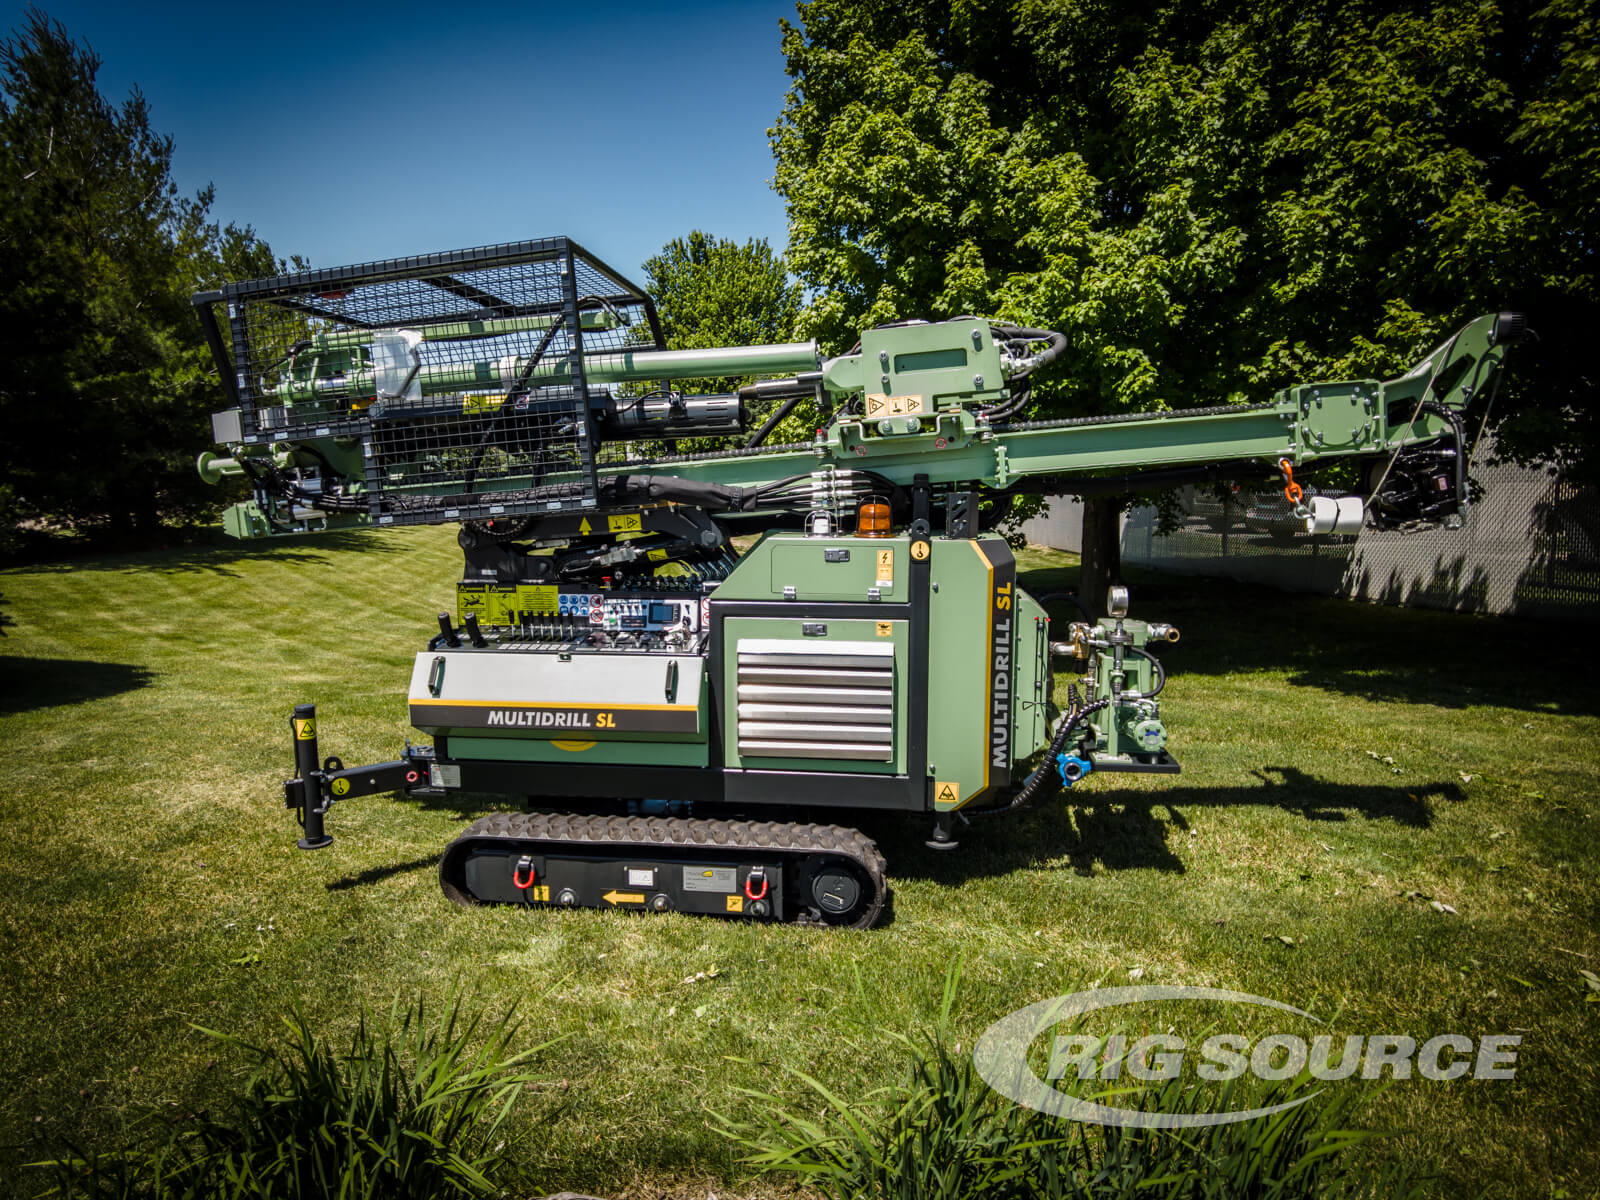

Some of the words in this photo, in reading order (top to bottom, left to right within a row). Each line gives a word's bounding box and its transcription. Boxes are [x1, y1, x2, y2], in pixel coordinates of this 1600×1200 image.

[996, 581, 1012, 611] SL
[993, 618, 1010, 768] MULTIDRILL
[487, 710, 591, 728] MULTIDRILL
[595, 713, 616, 728] SL
